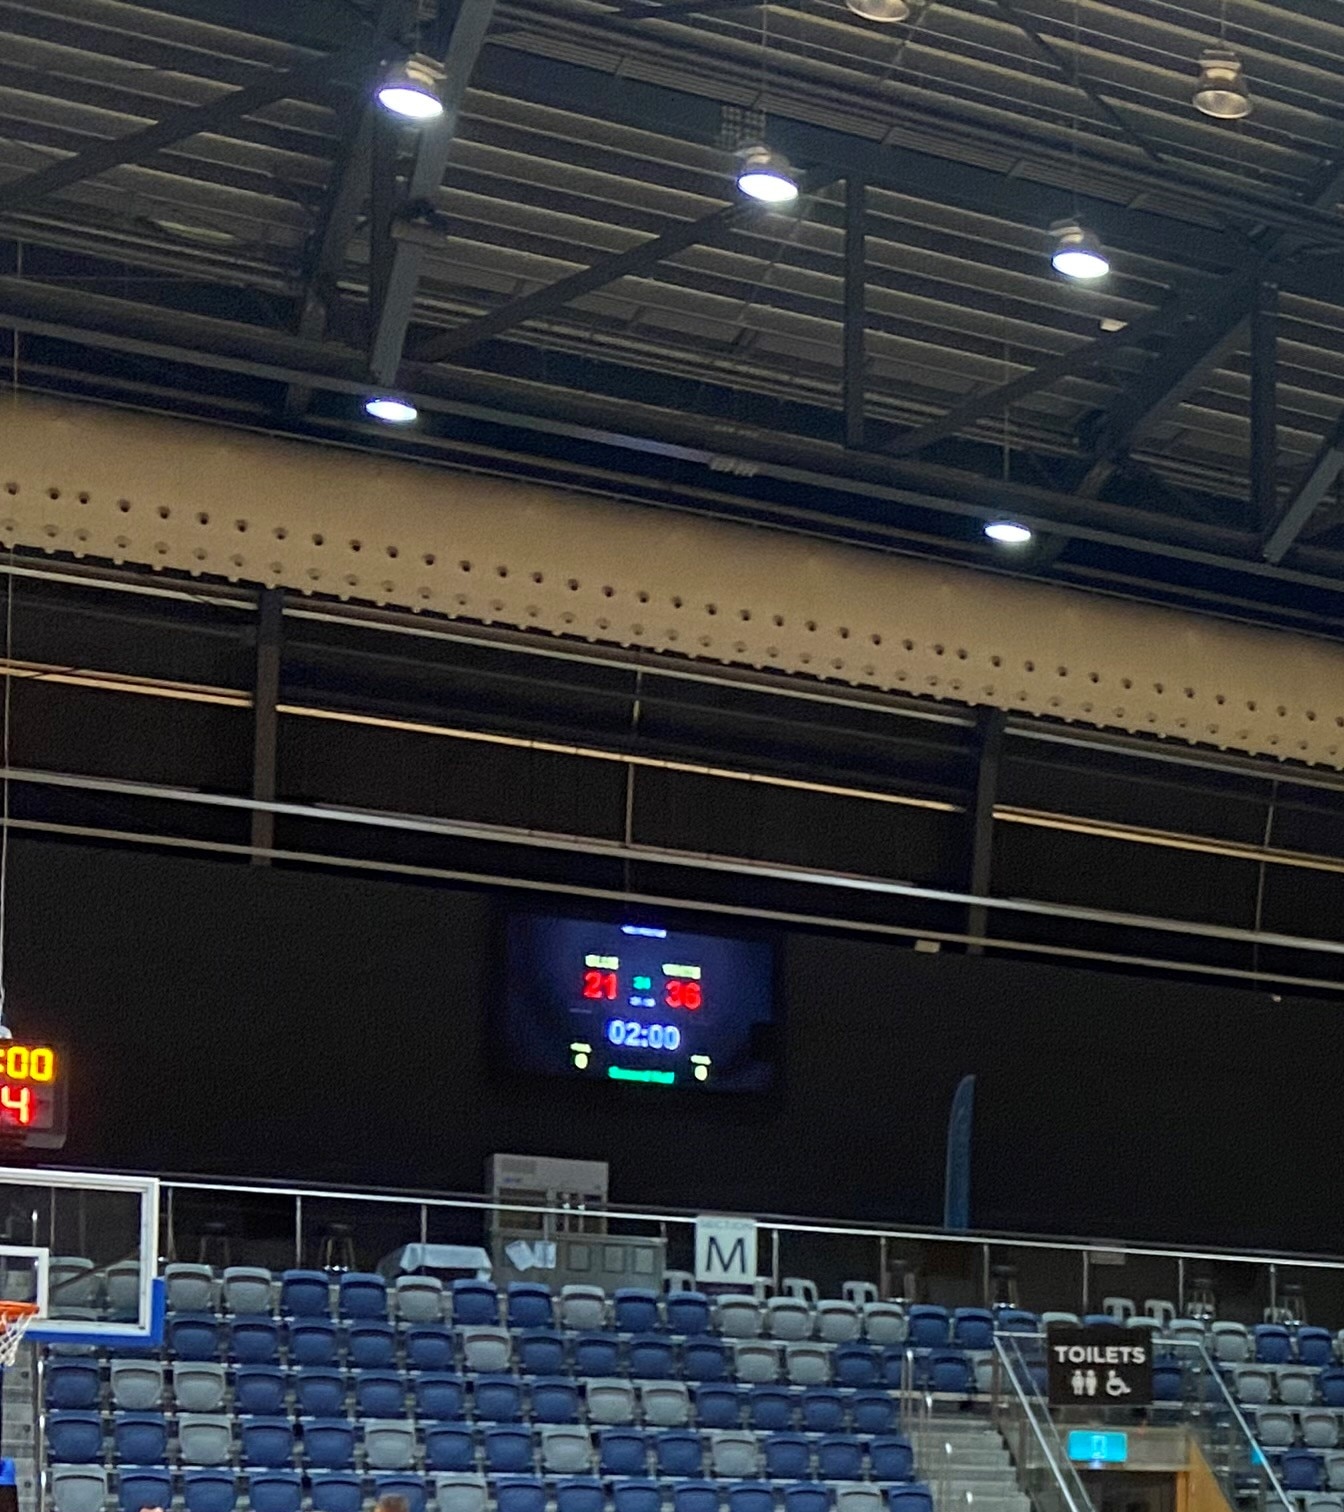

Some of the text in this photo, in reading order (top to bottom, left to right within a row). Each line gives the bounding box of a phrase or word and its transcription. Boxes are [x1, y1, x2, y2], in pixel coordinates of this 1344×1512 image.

[583, 971, 618, 1000] 21
[665, 979, 702, 1010] 36
[608, 1019, 681, 1050] 02:00
[1, 1085, 30, 1124] 4
[705, 1236, 746, 1274] M
[1053, 1345, 1146, 1364] TOILETS
